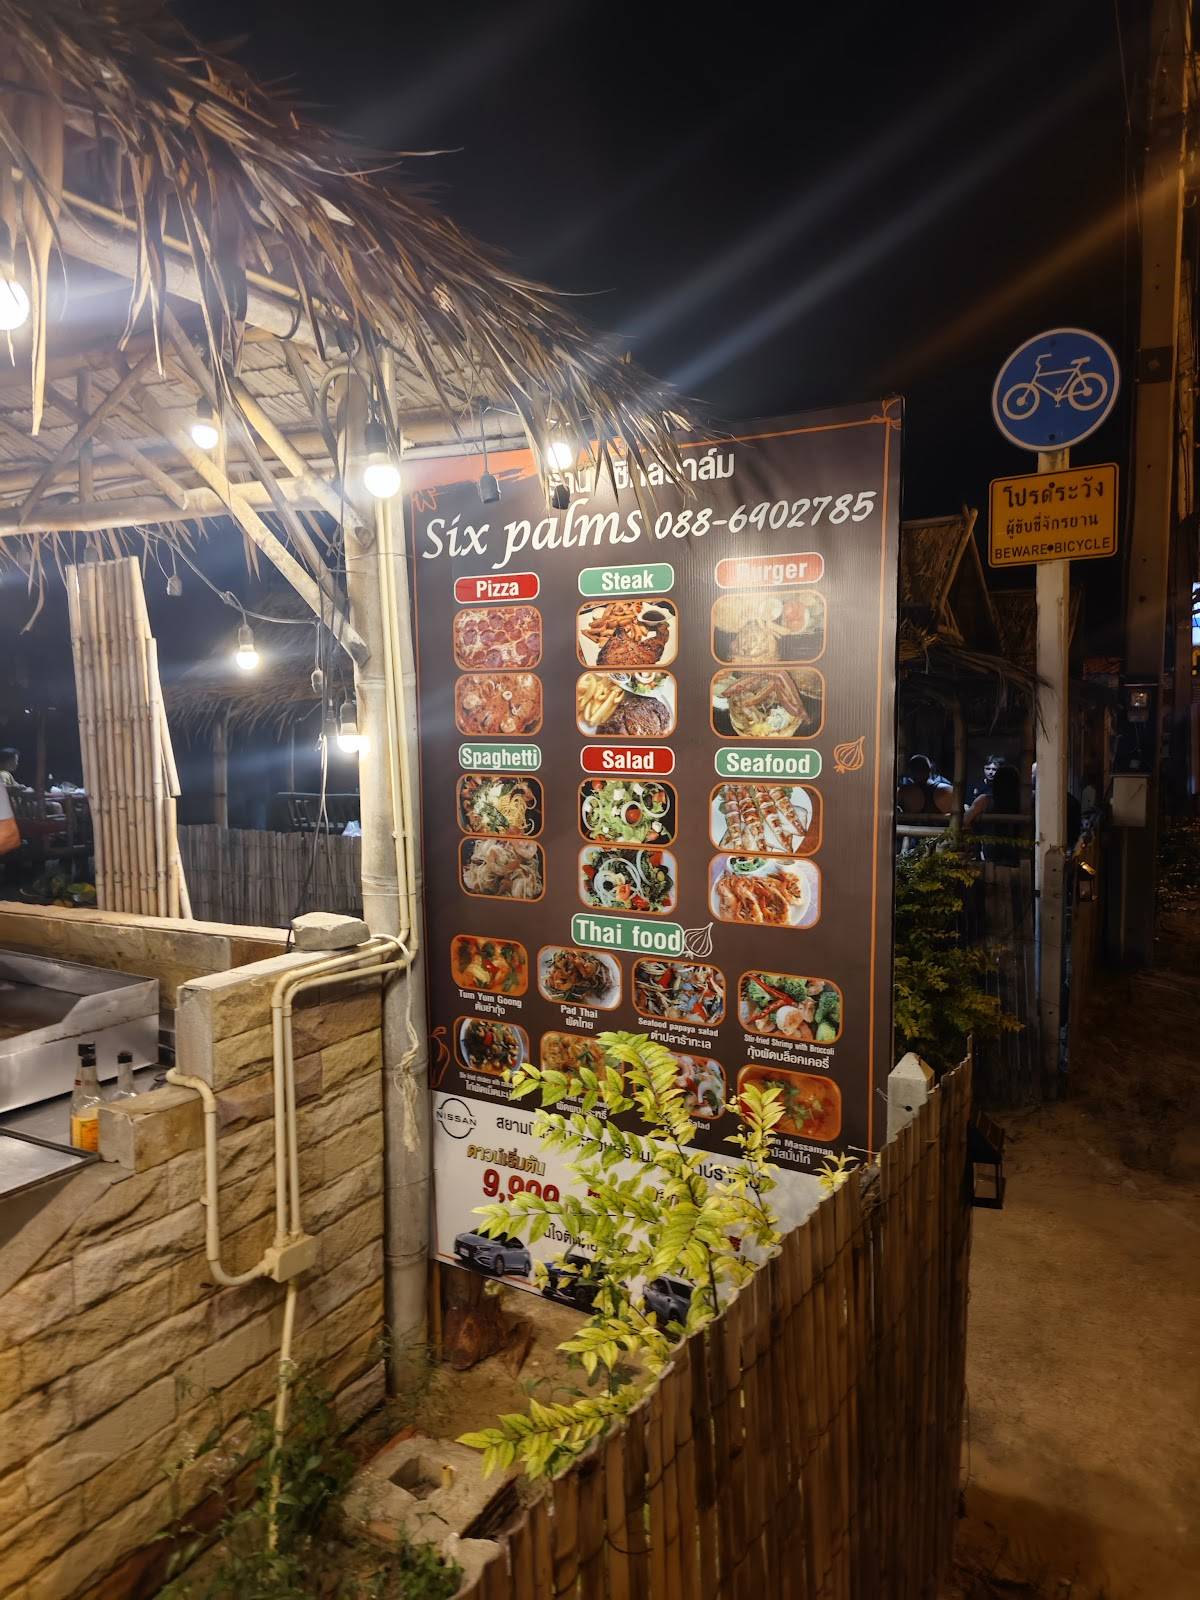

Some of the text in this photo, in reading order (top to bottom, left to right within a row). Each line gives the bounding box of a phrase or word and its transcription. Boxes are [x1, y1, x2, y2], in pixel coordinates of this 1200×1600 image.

[422, 491, 878, 570] Six palms 088-6902785
[1006, 512, 1099, 539] ผู้ขับขี่จักรยาน
[994, 536, 1111, 560] BEWARE BICYCLE
[476, 580, 520, 598] Pizza
[601, 571, 654, 591] Steak
[462, 748, 538, 768] Spaghetti
[602, 750, 655, 770] Salad
[726, 752, 810, 774] Seafood
[575, 919, 681, 952] Thai food
[497, 995, 523, 1009] Goong
[560, 1005, 598, 1019] Pad Thai
[638, 1017, 719, 1037] Seafood papaya salad
[435, 1110, 477, 1126] NISSAN
[784, 1139, 834, 1156] Massaman
